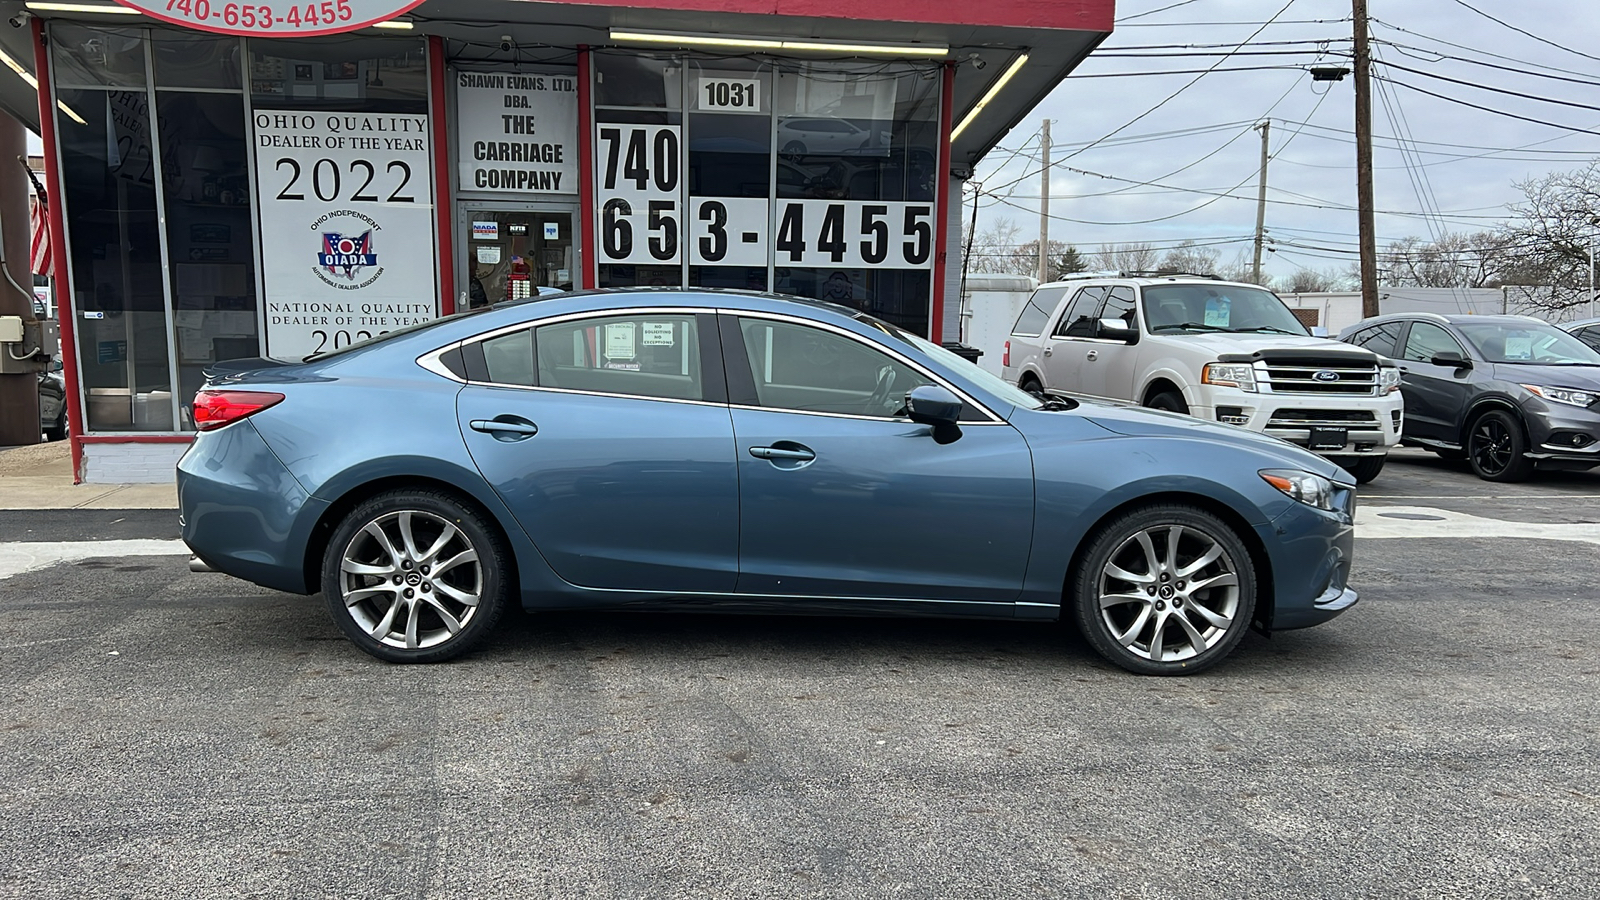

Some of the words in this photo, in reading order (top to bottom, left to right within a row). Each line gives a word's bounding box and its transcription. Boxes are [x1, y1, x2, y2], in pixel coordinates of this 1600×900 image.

[460, 74, 504, 89] SHAWN
[507, 76, 547, 91] EVANS.
[552, 78, 575, 92] LTD.
[504, 95, 532, 109] DBA.
[705, 82, 754, 107] 1031
[112, 108, 142, 133] EALER
[256, 115, 315, 130] OHIO
[327, 116, 426, 133] QUALITY
[502, 114, 535, 135] THE
[260, 135, 321, 148] DEALER
[325, 136, 346, 149] OF
[349, 136, 380, 149] THE
[384, 138, 425, 151] YEAR
[474, 141, 563, 164] CARRIAGE
[601, 128, 678, 192] 740
[274, 157, 416, 203] 2022
[475, 168, 562, 190] COMPANY
[310, 214, 328, 230] OHIO
[328, 210, 382, 232] INDEPENDENT
[325, 254, 367, 265] OIADA
[312, 266, 337, 288] AUTOMOBILE
[360, 266, 384, 288] ASSOCIATION
[270, 302, 354, 313] NATIONAL
[361, 303, 432, 314] QUALITY
[272, 316, 328, 325] DEALER
[336, 316, 352, 325] OF
[359, 316, 387, 325] THE
[312, 330, 391, 354] 20
